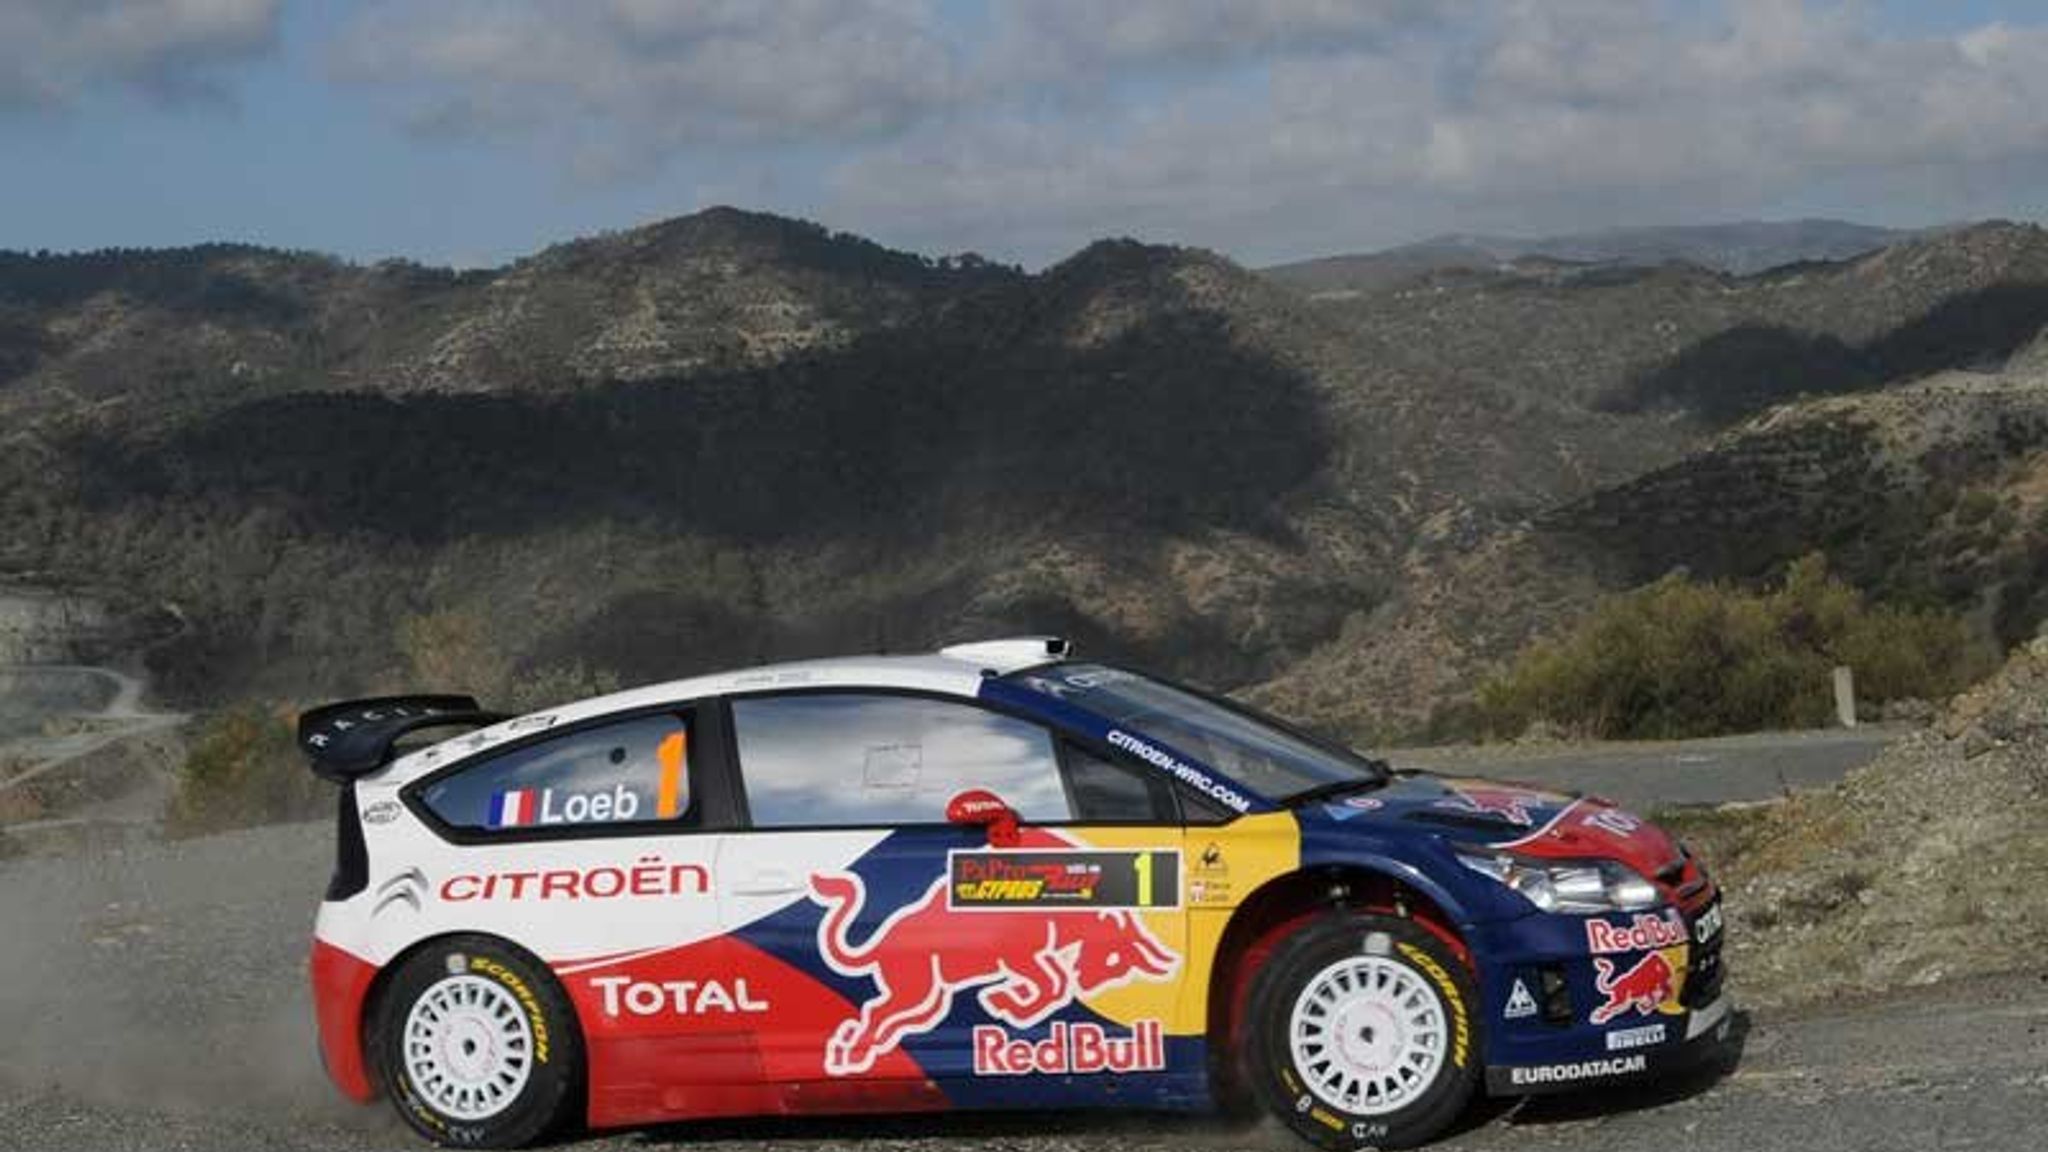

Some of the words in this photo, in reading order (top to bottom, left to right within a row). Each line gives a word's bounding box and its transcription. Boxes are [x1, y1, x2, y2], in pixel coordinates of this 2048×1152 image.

[656, 731, 686, 820] 1
[1106, 729, 1250, 813] CITROEN-WRC.COM
[540, 785, 639, 823] Loeb
[1134, 852, 1153, 905] 1
[470, 956, 550, 1064] SCORPION
[589, 975, 769, 1017] TOTAL
[1395, 941, 1470, 1069] SCORPION
[974, 1023, 1068, 1075] Red
[1070, 1020, 1167, 1073] Bull
[1606, 1024, 1667, 1050] PIRELLI
[1511, 1055, 1647, 1084] EURODATACAR
